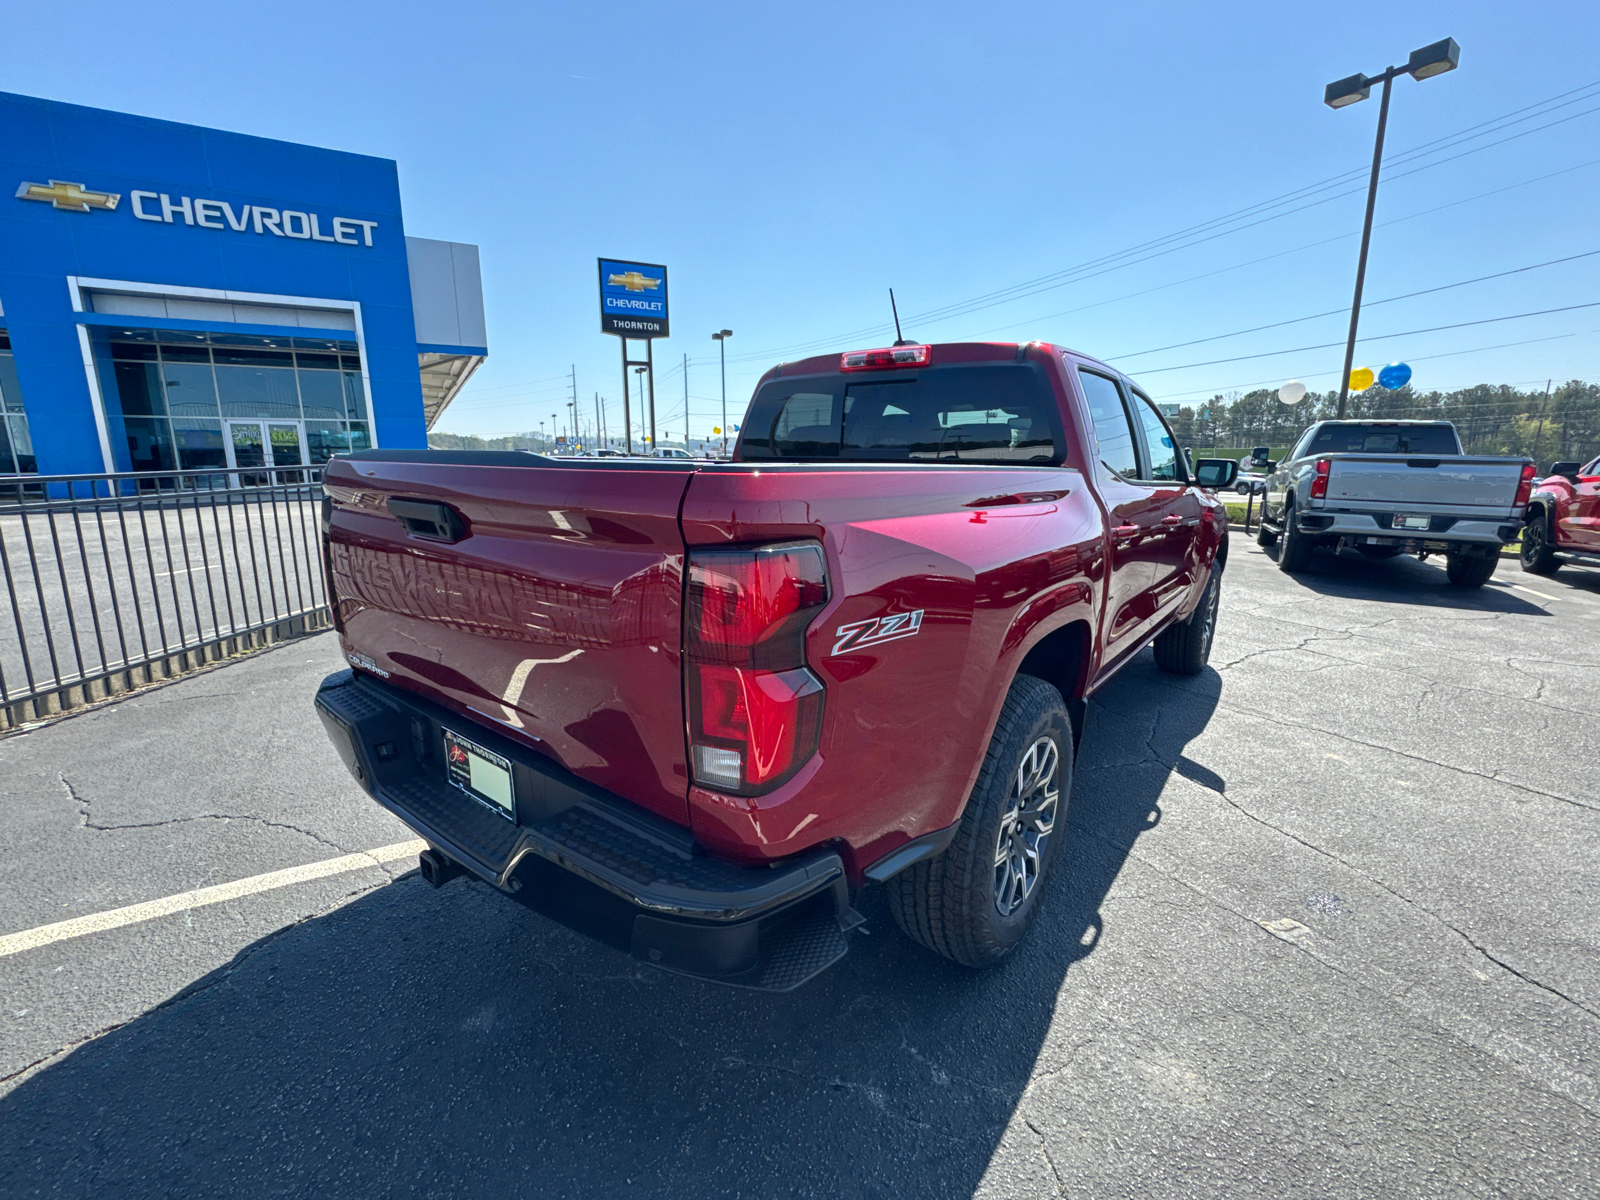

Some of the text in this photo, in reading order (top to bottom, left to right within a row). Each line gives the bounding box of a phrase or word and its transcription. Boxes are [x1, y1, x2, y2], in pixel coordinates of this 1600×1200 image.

[131, 190, 378, 247] CHEVROLET
[606, 297, 662, 311] CHEVROLET
[613, 319, 660, 331] THORNTON
[830, 609, 925, 657] Z71
[348, 654, 390, 679] COLORADO
